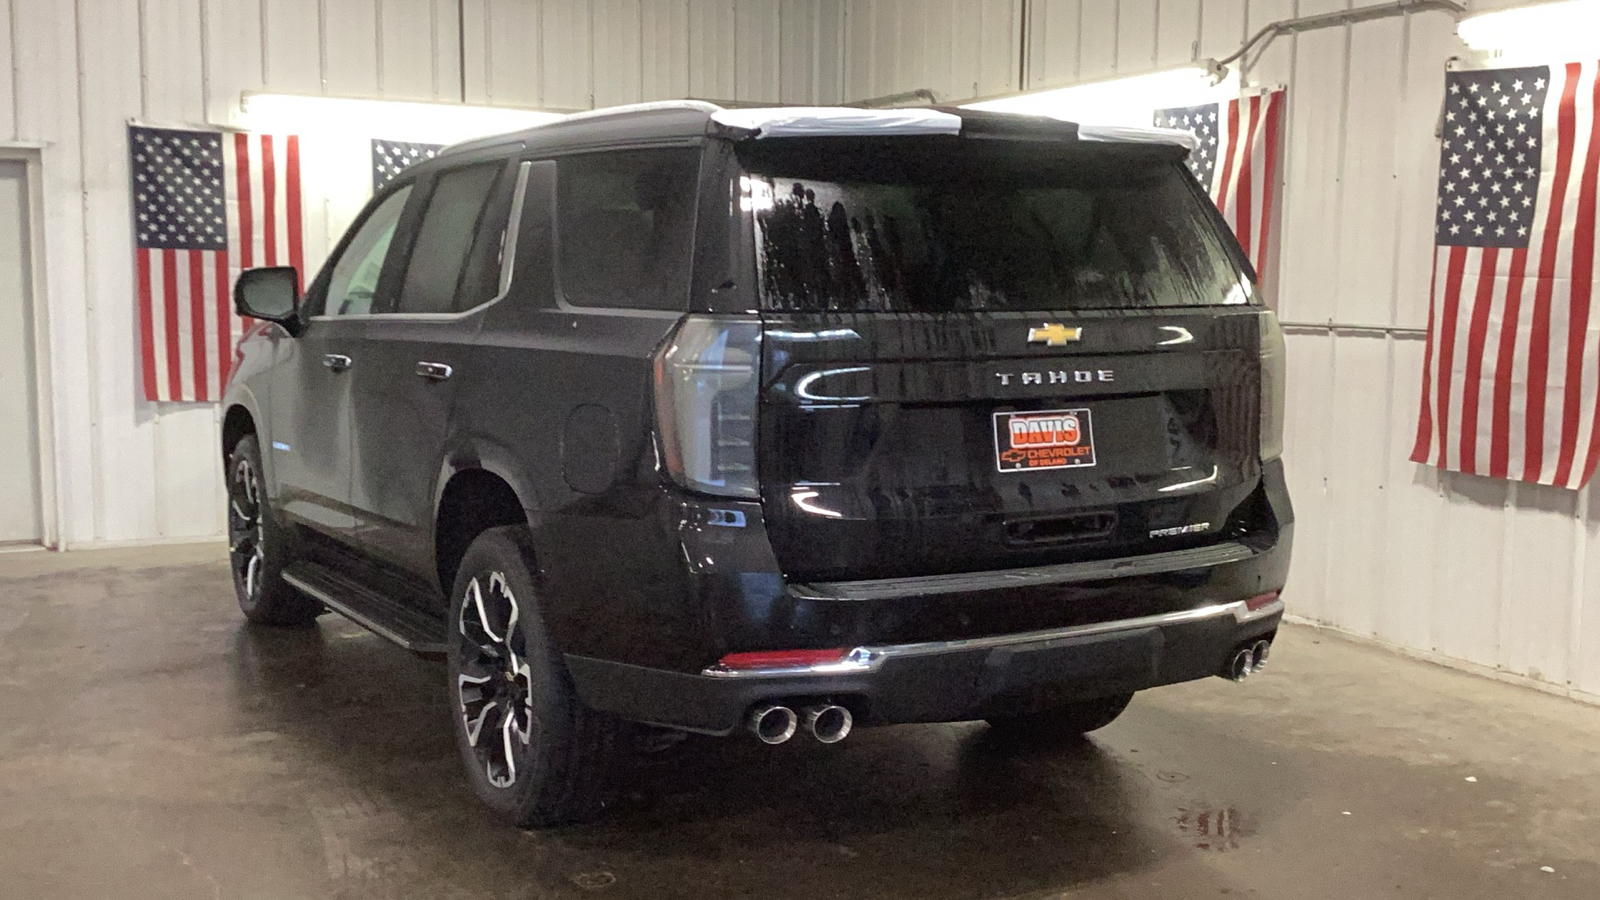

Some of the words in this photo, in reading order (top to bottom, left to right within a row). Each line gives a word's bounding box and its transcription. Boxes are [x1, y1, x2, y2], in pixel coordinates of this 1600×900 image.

[995, 369, 1115, 386] TAHOE
[1010, 417, 1079, 447] DAVIS
[1027, 446, 1091, 458] CHEVROLET
[1028, 459, 1038, 467] OF
[1149, 522, 1210, 538] PREMIER
